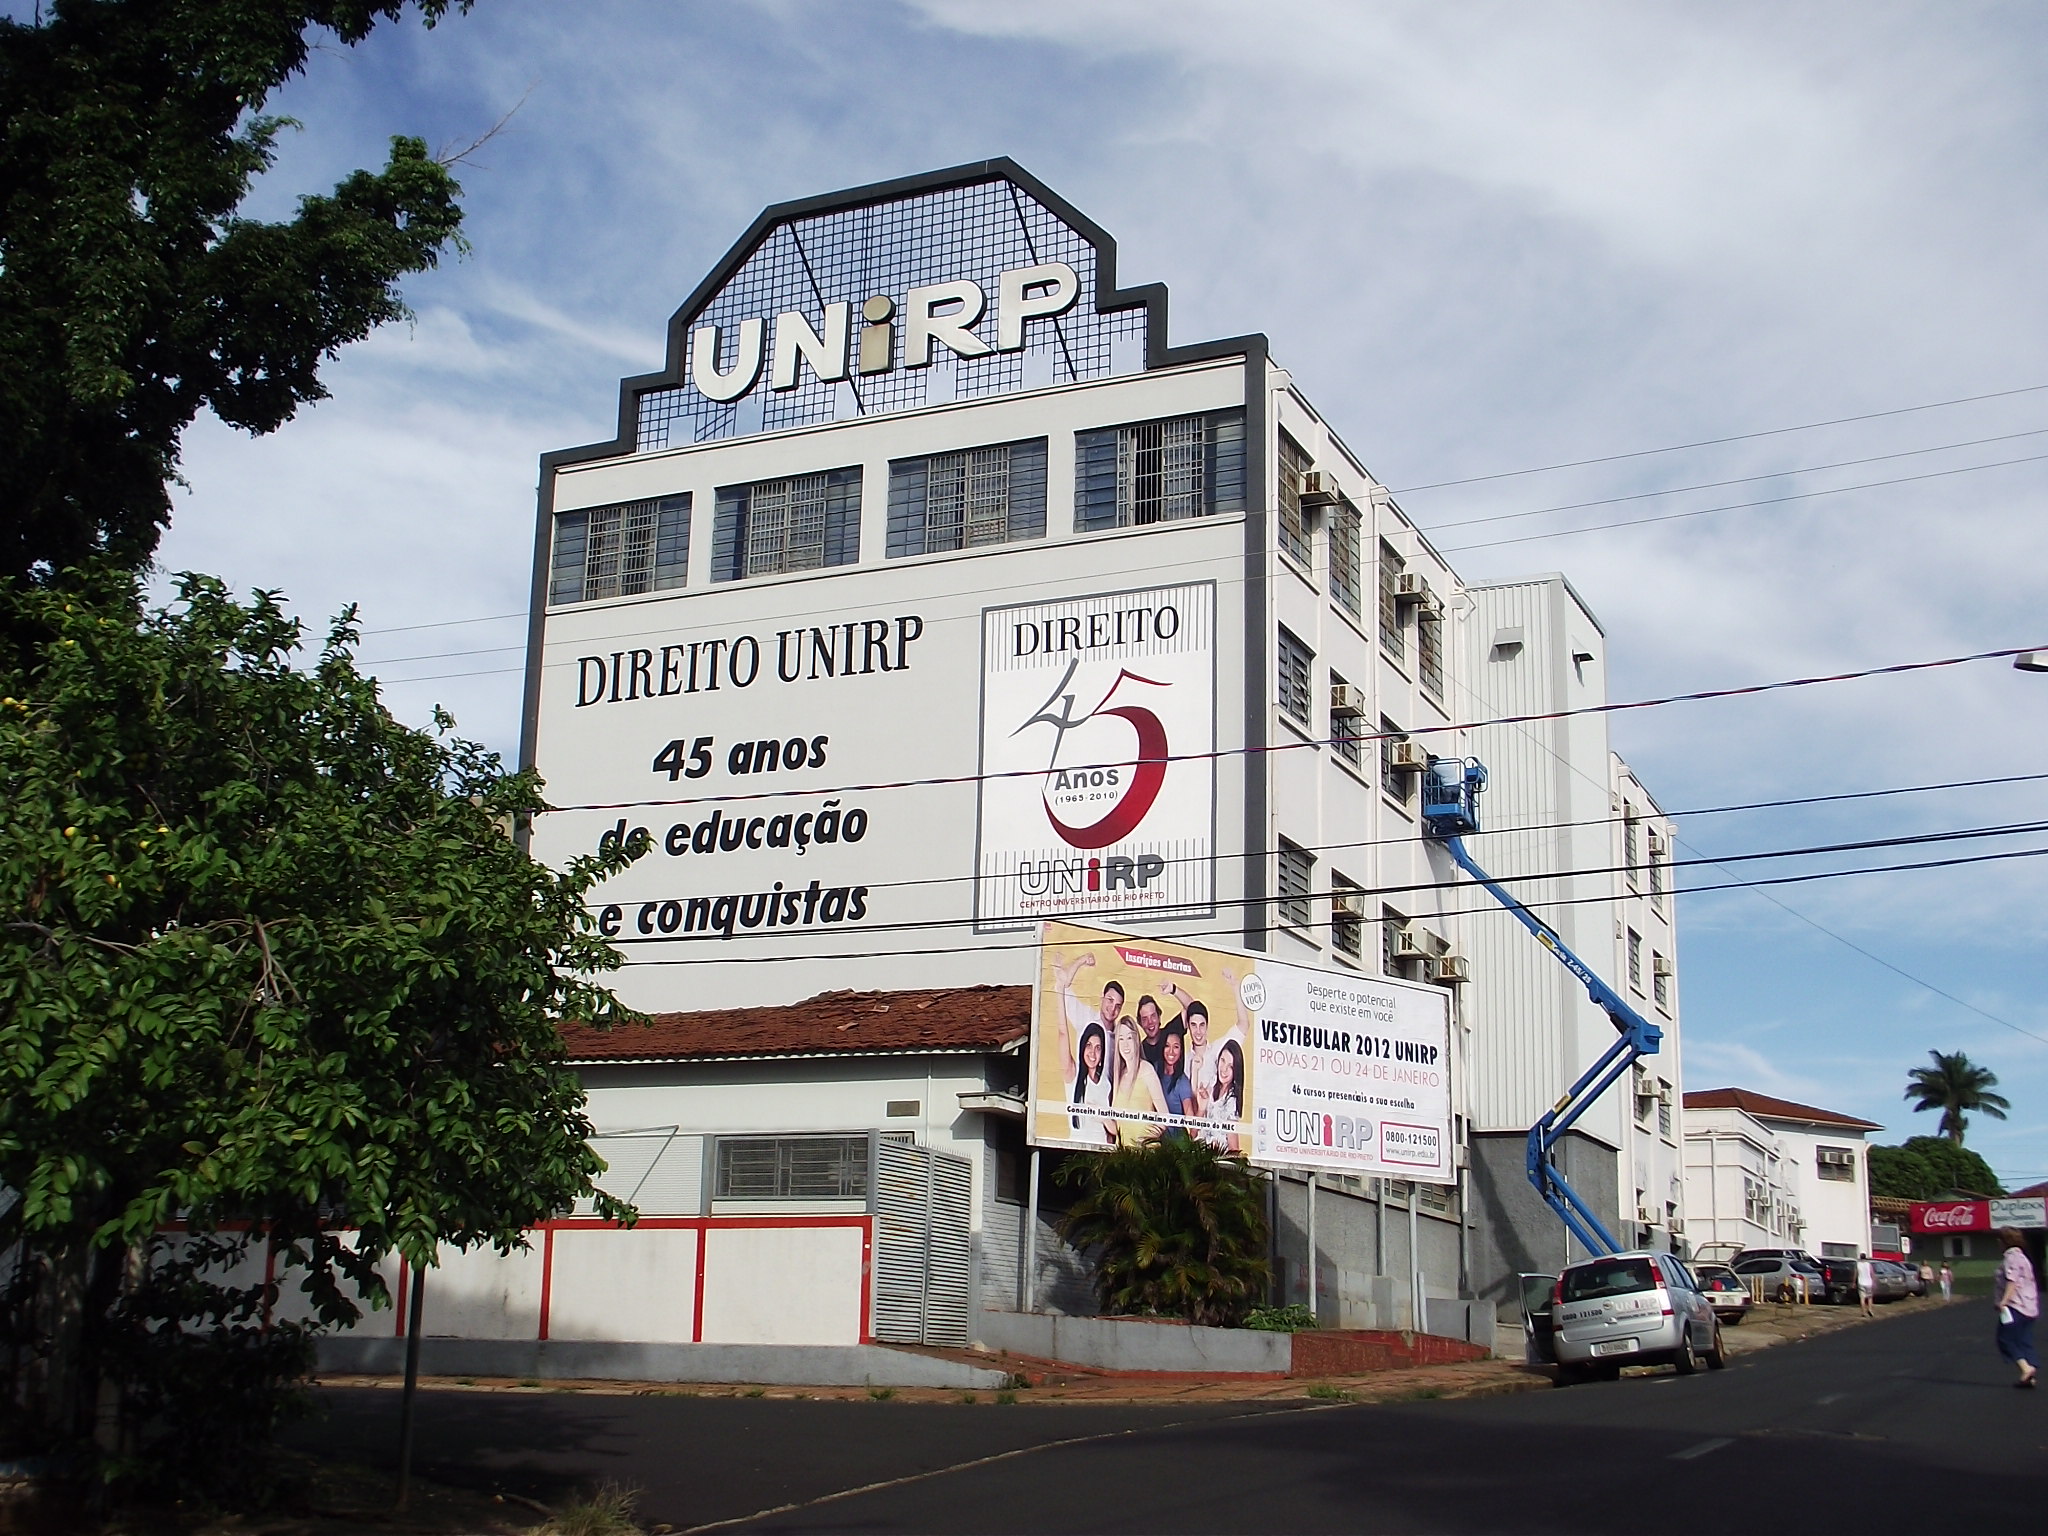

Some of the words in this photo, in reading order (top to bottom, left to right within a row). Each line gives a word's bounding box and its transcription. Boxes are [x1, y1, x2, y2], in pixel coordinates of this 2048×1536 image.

[1013, 605, 1179, 657] DIREITO
[574, 635, 760, 707] DIREITO
[775, 615, 924, 683] UNIRP
[651, 735, 714, 781] 45
[727, 734, 829, 776] anos
[1007, 657, 1173, 850] 45
[1054, 767, 1120, 791] Anos
[1055, 790, 1119, 806] (1965-2010)
[599, 818, 650, 863] de
[664, 799, 868, 856] educação
[599, 904, 622, 936] e
[637, 881, 868, 940] conquistas
[1020, 900, 1051, 909] CENTRO
[1112, 894, 1121, 902] DE
[1124, 893, 1137, 901] RIO
[1139, 891, 1165, 900] PRETO
[1163, 958, 1192, 972] abertas
[1243, 981, 1262, 994] 100%
[1245, 991, 1263, 1005] VOCÊ
[1307, 982, 1347, 1001] Desperte
[1349, 993, 1355, 1002] o
[1356, 993, 1396, 1009] potencial
[1310, 1000, 1326, 1012] que
[1329, 1003, 1356, 1017] existe
[1358, 1009, 1372, 1019] em
[1373, 1010, 1394, 1022] você
[1261, 1019, 1351, 1053] VESTIBULAR
[1355, 1034, 1390, 1059] 2012
[1395, 1040, 1438, 1065] UNIRP
[1260, 1048, 1308, 1070] PROVAS
[1311, 1056, 1325, 1072] 21
[1330, 1058, 1350, 1075] OU
[1355, 1062, 1368, 1077] 24
[1373, 1064, 1388, 1081] DE
[1392, 1068, 1440, 1088] JANEIRO
[1292, 1084, 1301, 1095] 46
[1303, 1088, 1326, 1098] cursos
[1328, 1090, 1367, 1103] presenciais
[1369, 1096, 1375, 1104] a
[1376, 1097, 1388, 1106] sua
[1389, 1098, 1415, 1109] escolha
[1221, 1123, 1235, 1131] MEC
[1385, 1130, 1437, 1147] 0800-121500
[1275, 1145, 1298, 1154] CENTRO
[1340, 1150, 1347, 1158] DE
[1385, 1146, 1436, 1160] www.unirp.edu.br
